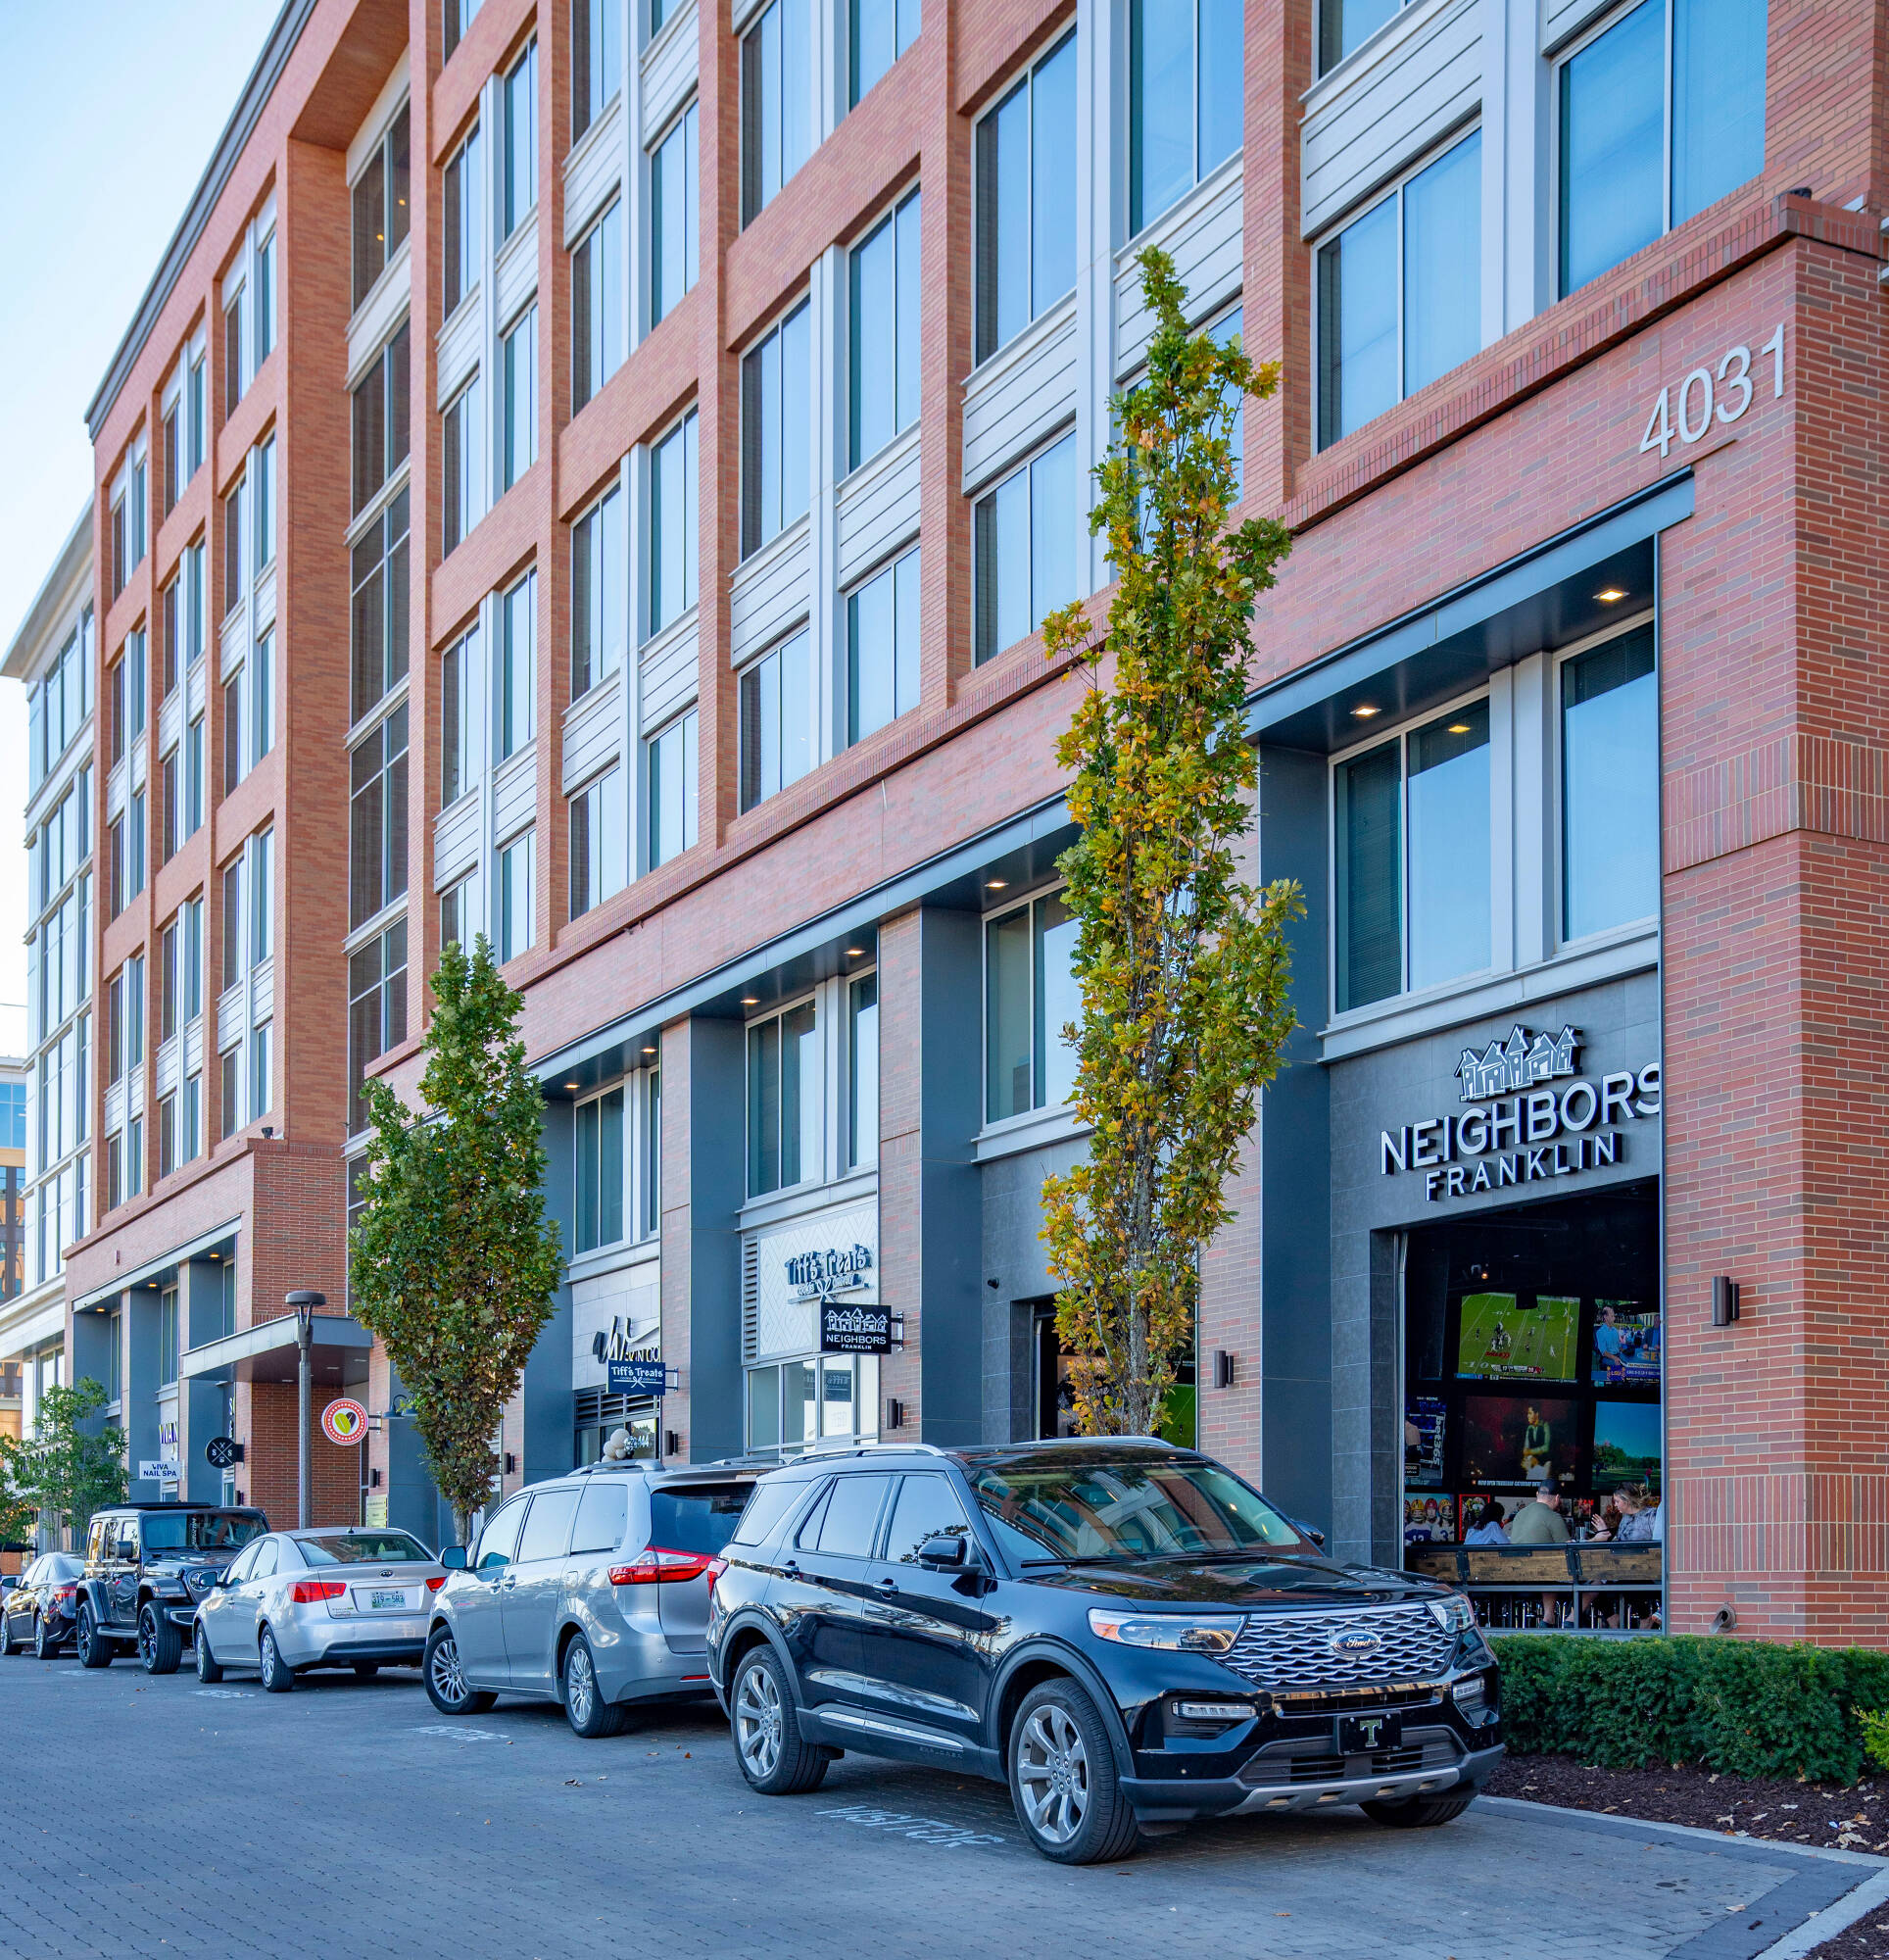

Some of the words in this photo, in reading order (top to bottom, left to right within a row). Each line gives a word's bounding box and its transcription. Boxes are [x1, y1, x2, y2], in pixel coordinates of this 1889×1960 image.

[1639, 322, 1785, 459] 4031
[1380, 1061, 1660, 1175] NEIGHBORS
[1426, 1131, 1619, 1201] FRANKLIN
[785, 1250, 821, 1286] Tiff's
[826, 1334, 887, 1345] NEIGHBORS
[610, 1365, 634, 1376] Tiff's
[634, 1367, 663, 1378] Treats
[1432, 1415, 1445, 1466] bet365
[1346, 1636, 1374, 1648] Ford
[1359, 1718, 1382, 1747] T
[814, 1804, 1006, 1848] VISITOR
